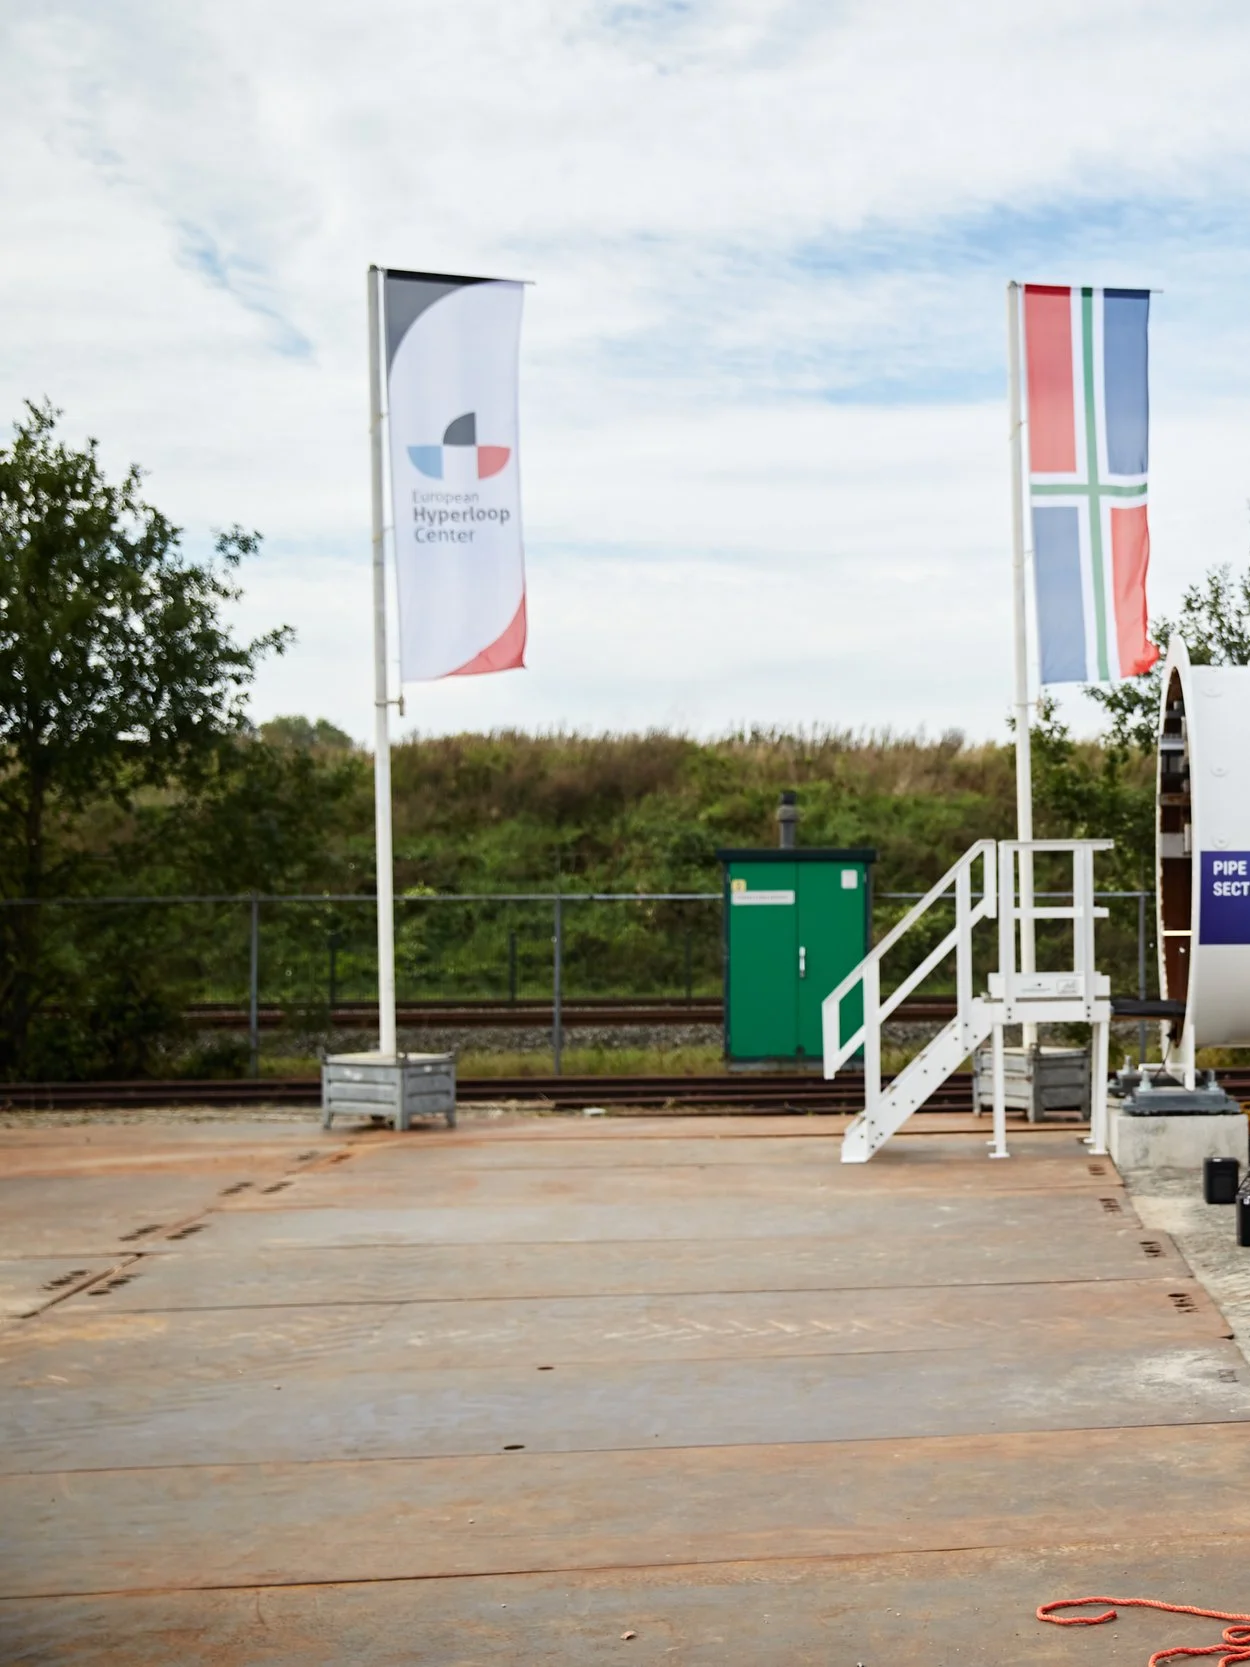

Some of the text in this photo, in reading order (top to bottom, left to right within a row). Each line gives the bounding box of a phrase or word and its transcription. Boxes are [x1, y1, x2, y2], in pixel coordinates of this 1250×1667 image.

[412, 489, 479, 505] European
[412, 506, 511, 526] Hyperloop
[414, 528, 475, 543] Center
[1212, 860, 1248, 876] PIPE
